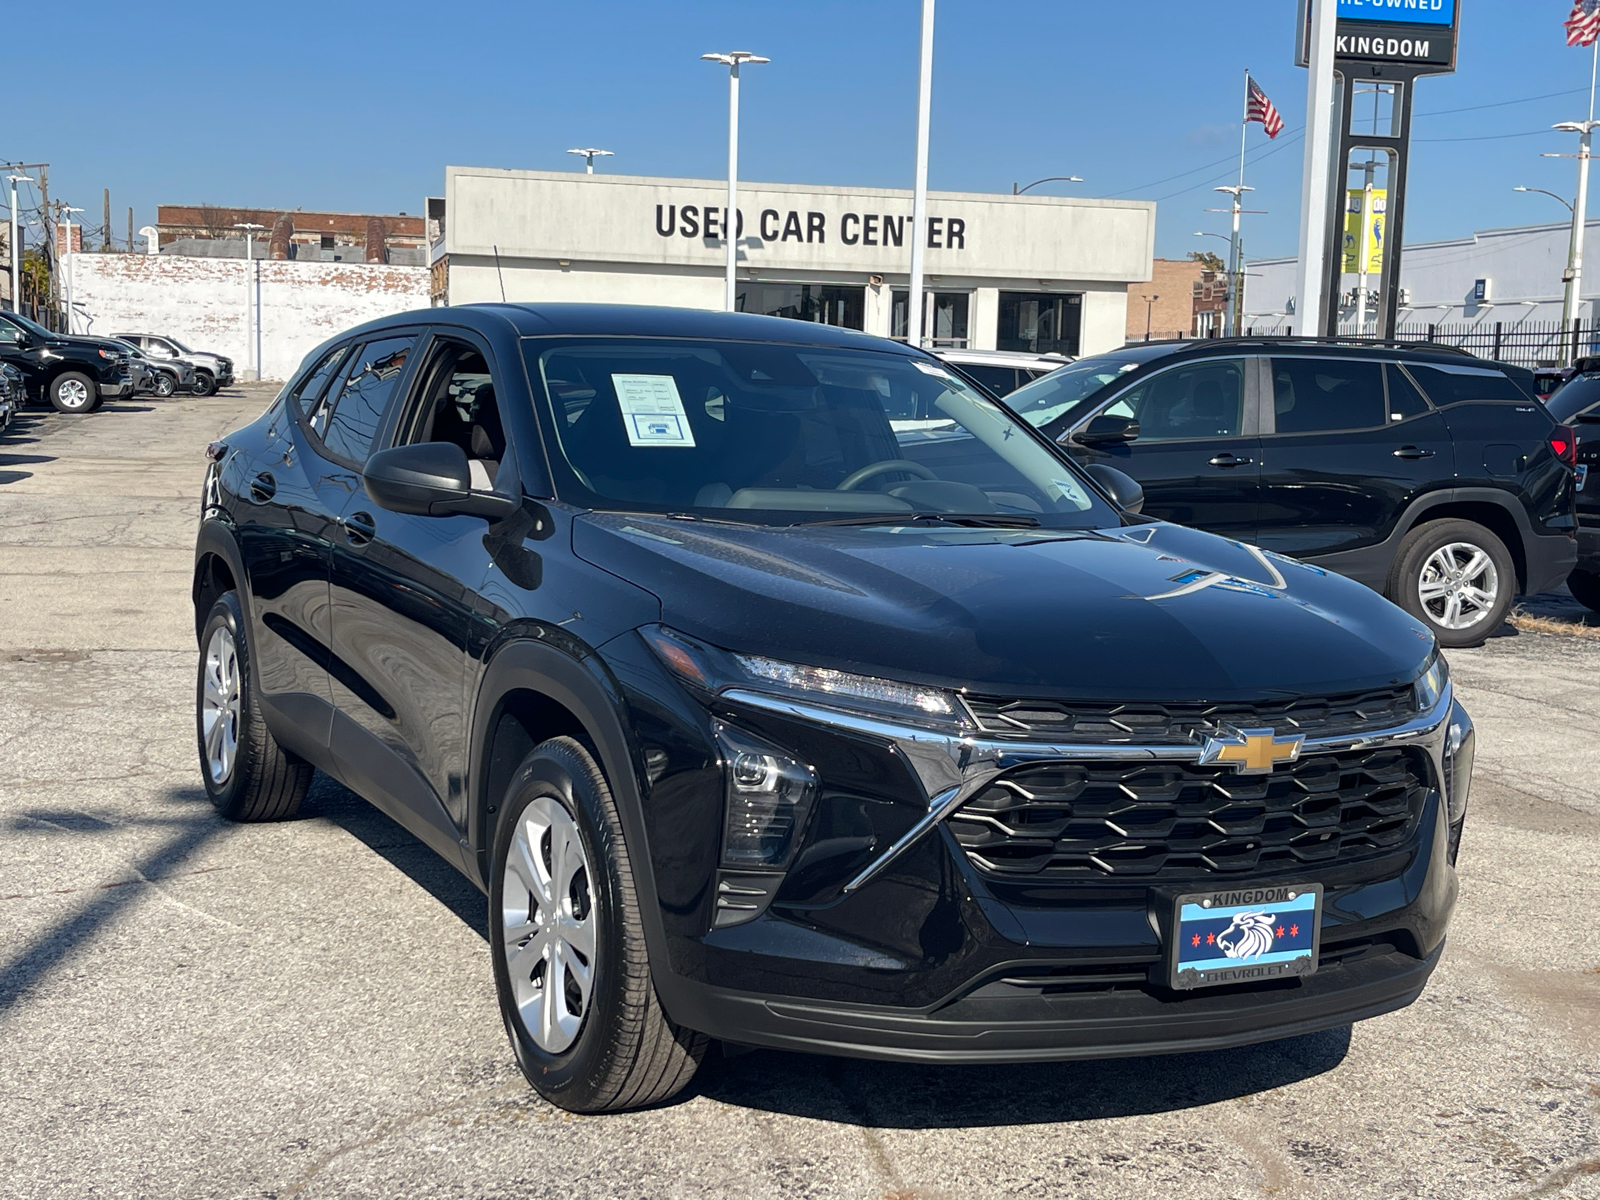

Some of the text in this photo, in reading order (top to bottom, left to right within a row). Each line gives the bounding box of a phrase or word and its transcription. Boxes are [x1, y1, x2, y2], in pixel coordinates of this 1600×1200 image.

[1336, 35, 1430, 57] KINGDOM
[655, 204, 966, 250] USED CAR CENER
[1212, 888, 1289, 907] KINGDOM
[1206, 964, 1285, 983] CHEVROLET
